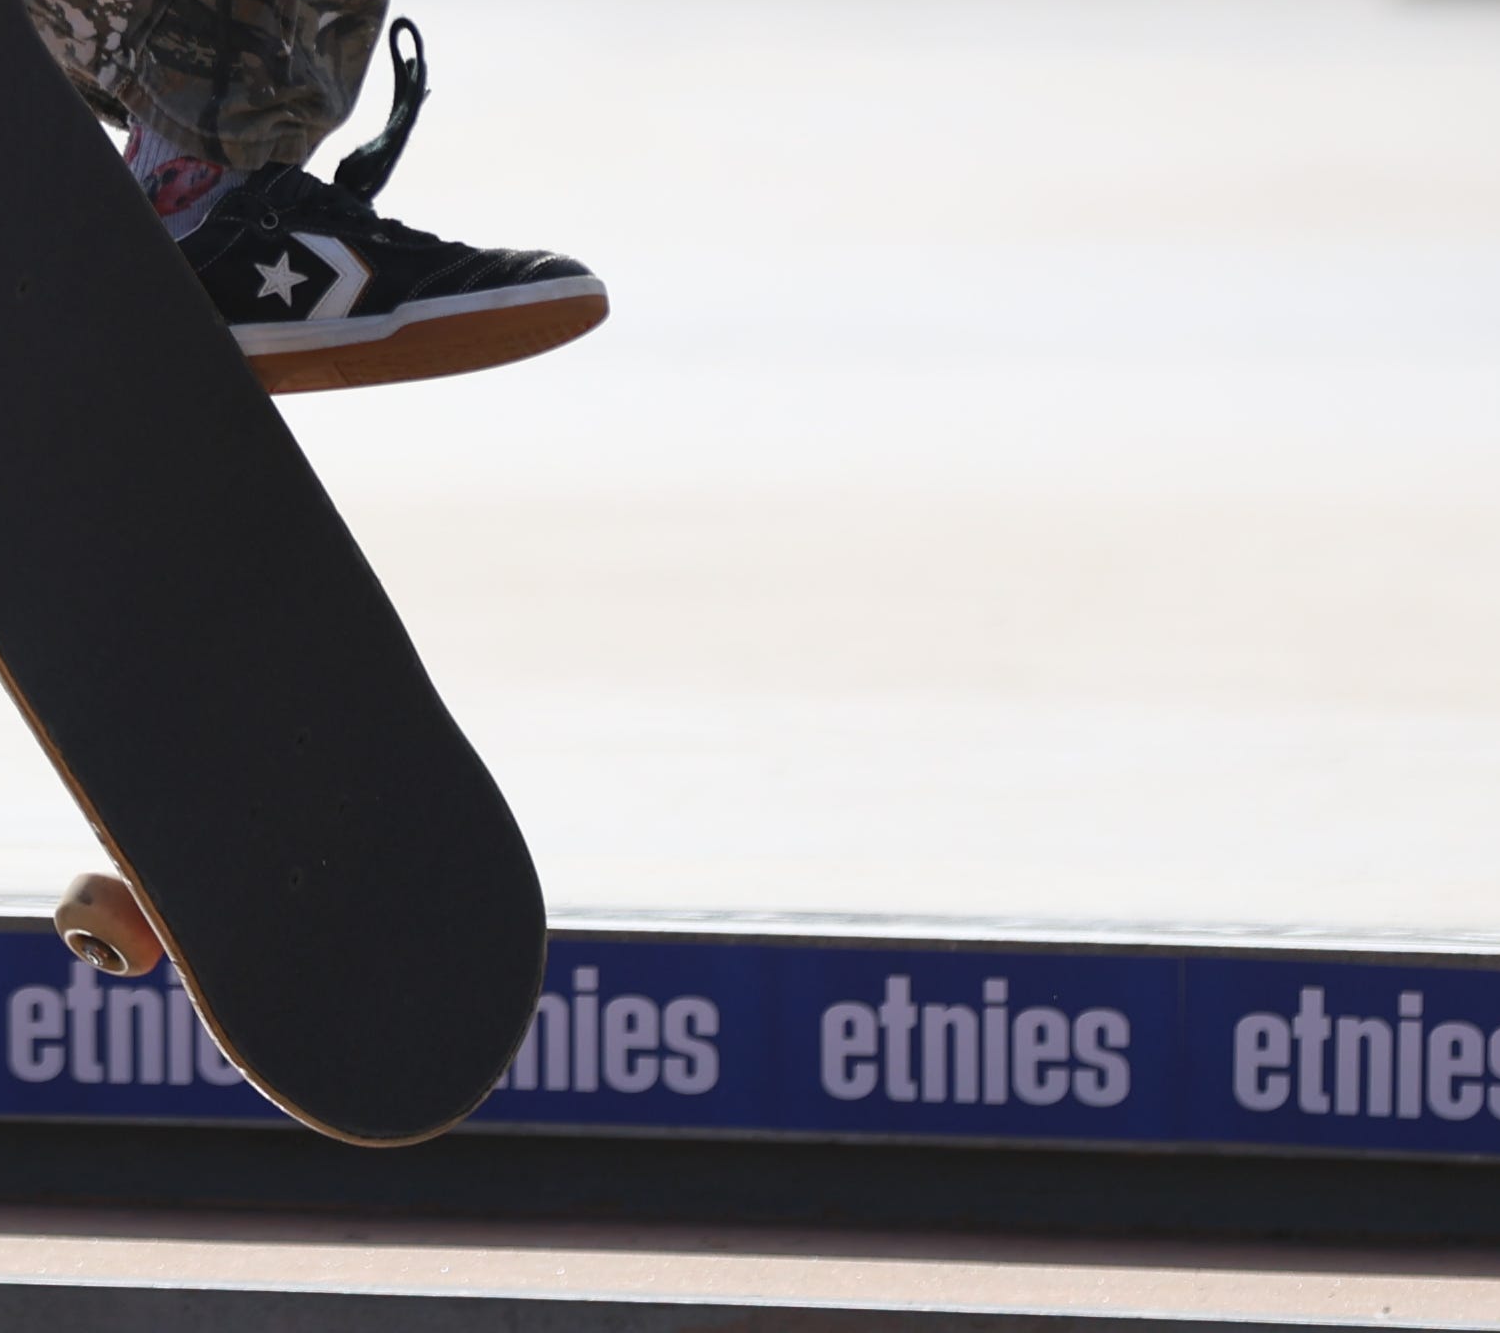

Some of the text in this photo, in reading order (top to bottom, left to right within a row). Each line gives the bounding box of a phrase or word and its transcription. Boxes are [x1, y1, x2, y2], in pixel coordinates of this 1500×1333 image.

[8, 959, 247, 1086] etni
[488, 966, 719, 1095] nies
[821, 975, 1131, 1107] etnies
